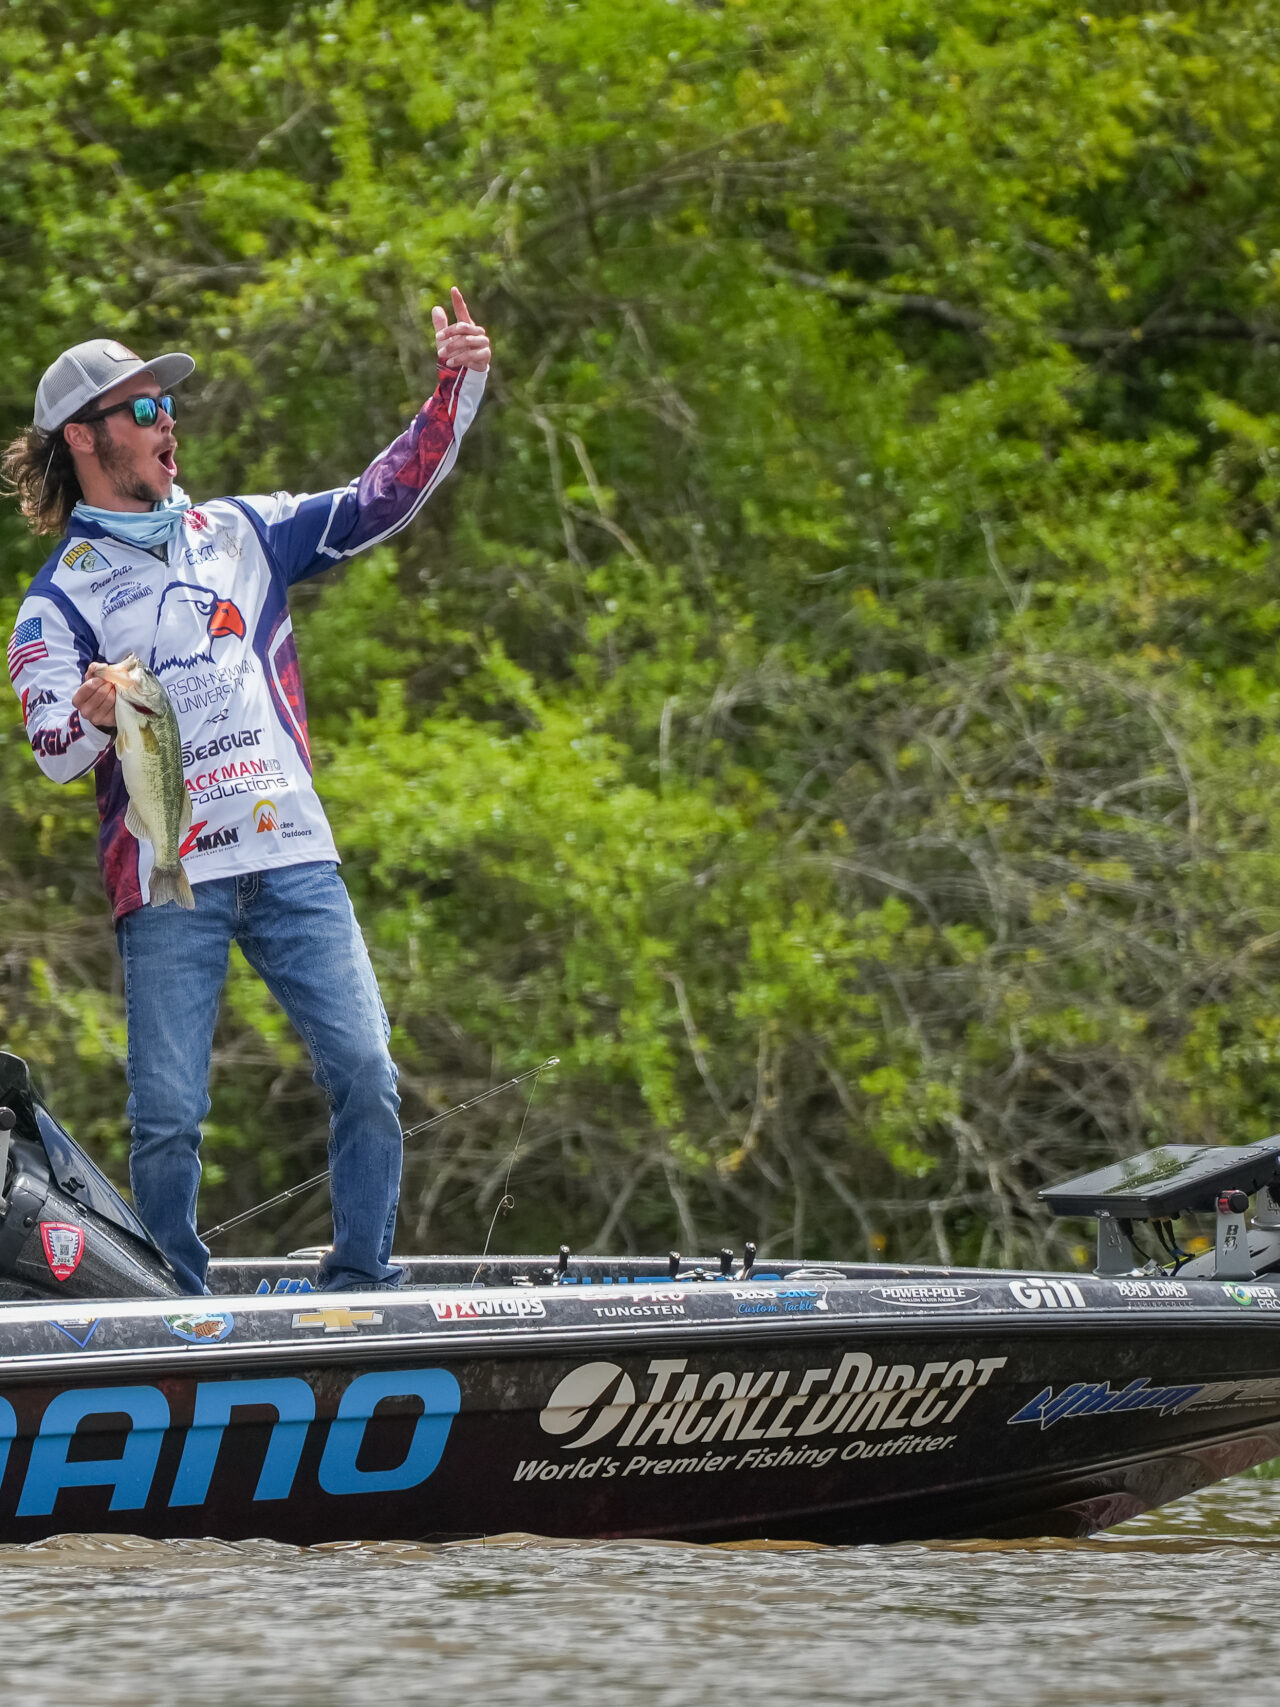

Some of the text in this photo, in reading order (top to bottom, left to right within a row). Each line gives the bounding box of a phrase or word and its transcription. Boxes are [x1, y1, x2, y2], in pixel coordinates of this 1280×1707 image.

[281, 829, 312, 839] Outdoors
[880, 1287, 966, 1298] POWER-POLE
[1008, 1278, 1086, 1309] Gill
[592, 1304, 686, 1317] TUNGSTEN
[738, 1300, 814, 1314] Custom Tackle
[512, 1433, 959, 1482] World's Premier Fishing Outfitter.
